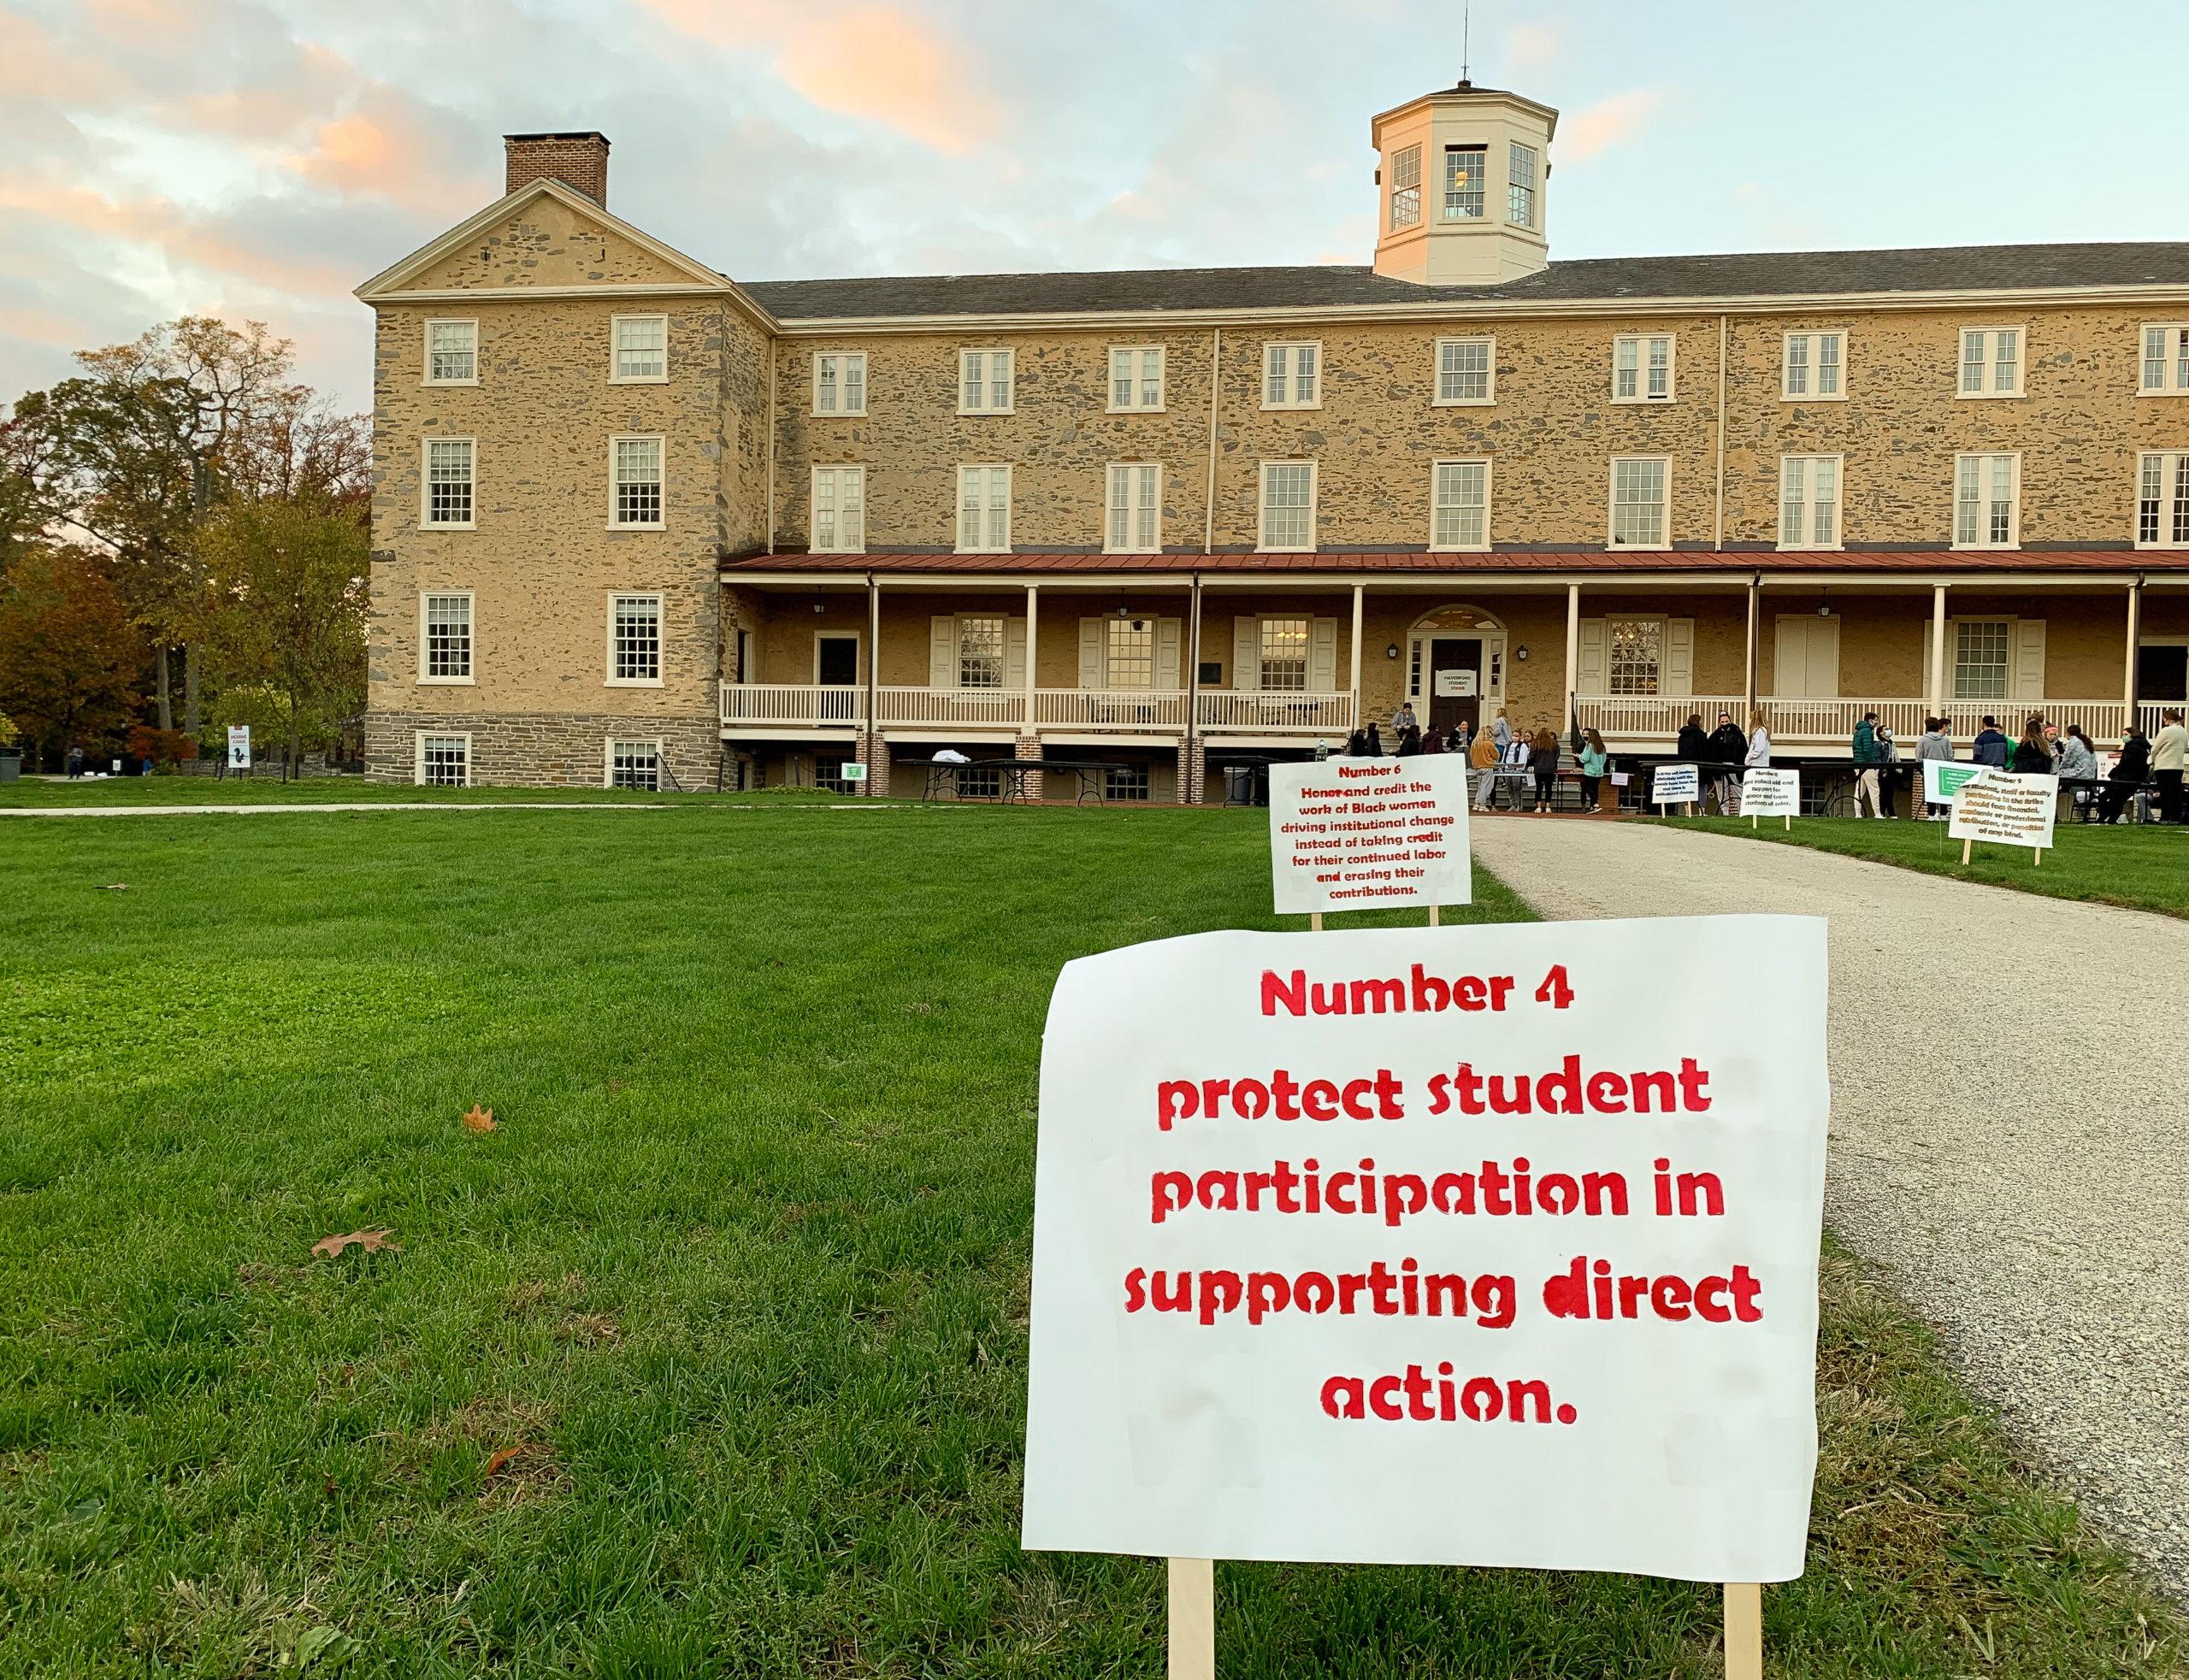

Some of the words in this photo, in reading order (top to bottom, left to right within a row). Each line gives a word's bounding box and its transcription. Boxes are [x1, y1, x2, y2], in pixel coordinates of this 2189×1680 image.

[1338, 765, 1391, 778] Number
[1393, 765, 1401, 775] 6
[1988, 774, 2016, 783] Number
[1301, 788, 1343, 799] Honor
[1343, 787, 1371, 798] and
[1373, 783, 1407, 796] credit
[1410, 782, 1432, 793] the
[1971, 784, 2000, 793] student,
[2027, 789, 2051, 798] faculty
[1299, 805, 1332, 815] work
[1335, 803, 1348, 814] of
[1351, 802, 1387, 814] Black
[1389, 800, 1437, 811] women
[1991, 802, 2006, 811] face
[2007, 805, 2040, 814] financial,
[1280, 823, 1327, 833] driving
[1330, 818, 1406, 831] institutional
[1409, 816, 1454, 827] change
[2003, 814, 2046, 822] professional
[1295, 839, 1342, 849] instead
[1344, 838, 1358, 848] of
[1361, 835, 1403, 847] taking
[1407, 831, 1443, 843] credit
[1292, 856, 1312, 866] for
[1313, 856, 1344, 865] their
[1347, 851, 1411, 864] continued
[1413, 848, 1446, 859] labor
[1316, 871, 1342, 882] and
[1344, 869, 1391, 881] erasing
[1395, 868, 1425, 878] their
[1329, 886, 1417, 899] contributions.
[1260, 962, 1515, 1017] Number
[1534, 964, 1576, 1010] 4
[1157, 1068, 1406, 1132] protect
[1426, 1053, 1713, 1116] student
[1151, 1156, 1630, 1228] participation
[1652, 1156, 1726, 1217] in
[1124, 1256, 1517, 1329] supporting
[1542, 1254, 1764, 1323] direct
[1319, 1360, 1578, 1425] action.
